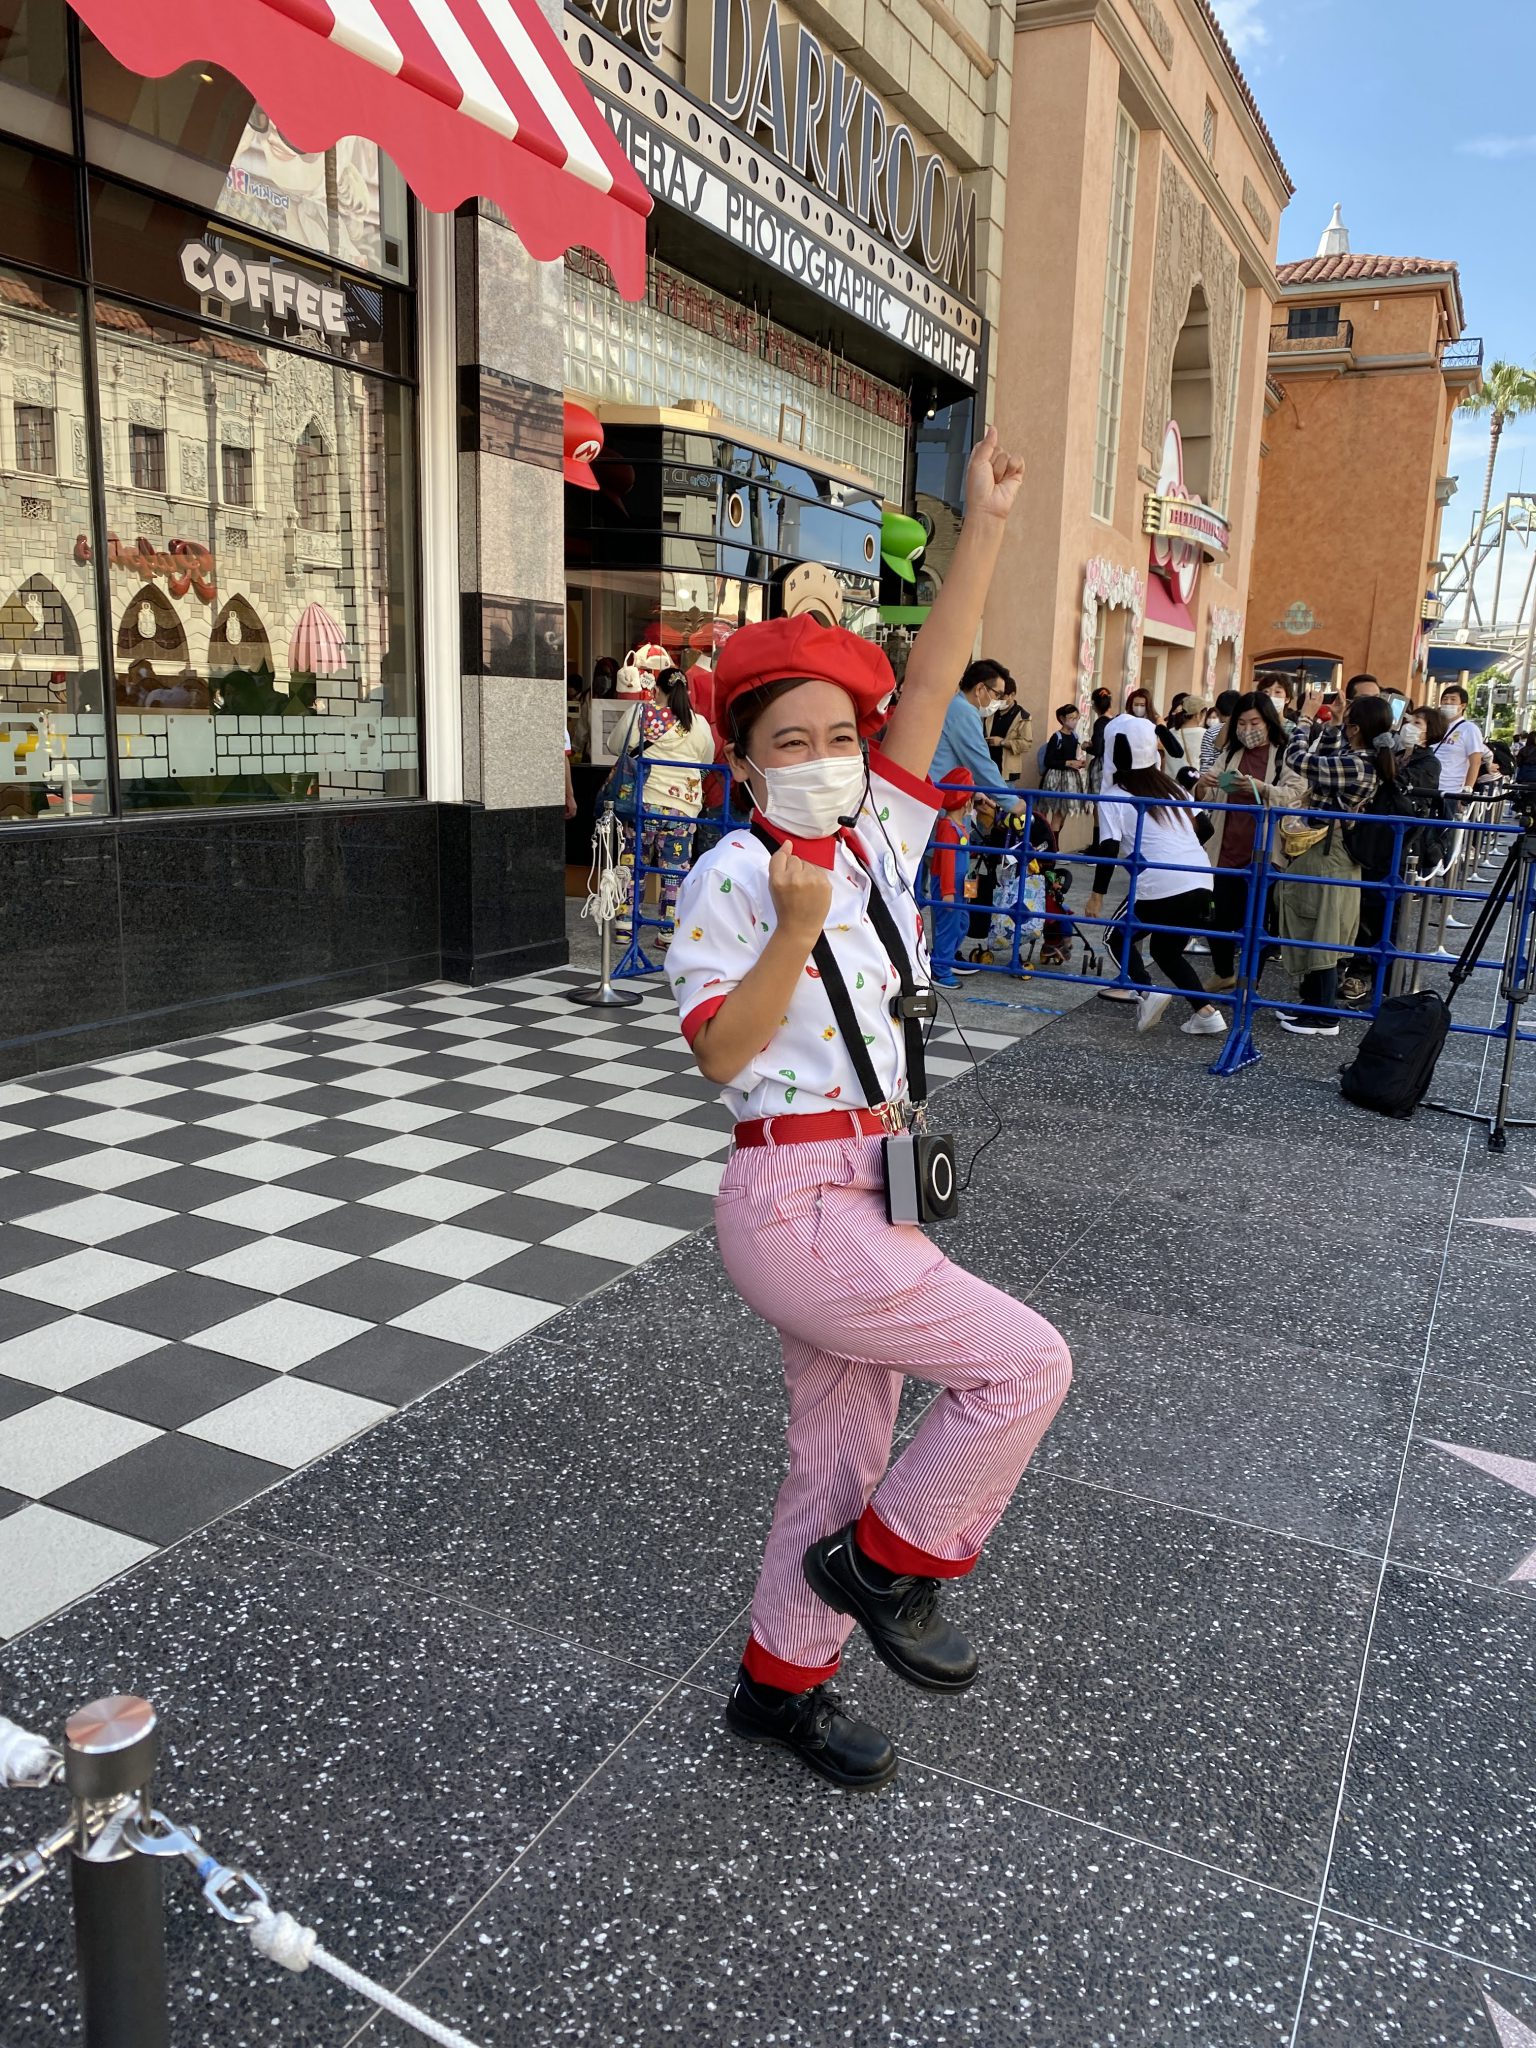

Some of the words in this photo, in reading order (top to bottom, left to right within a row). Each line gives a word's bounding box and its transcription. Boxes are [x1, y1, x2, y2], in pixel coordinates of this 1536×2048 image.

[710, 0, 977, 306] DARKROOM
[179, 242, 348, 334] COFFEE
[728, 190, 892, 332] PHOTOGRAPHIC
[901, 307, 974, 384] SUPPLIES
